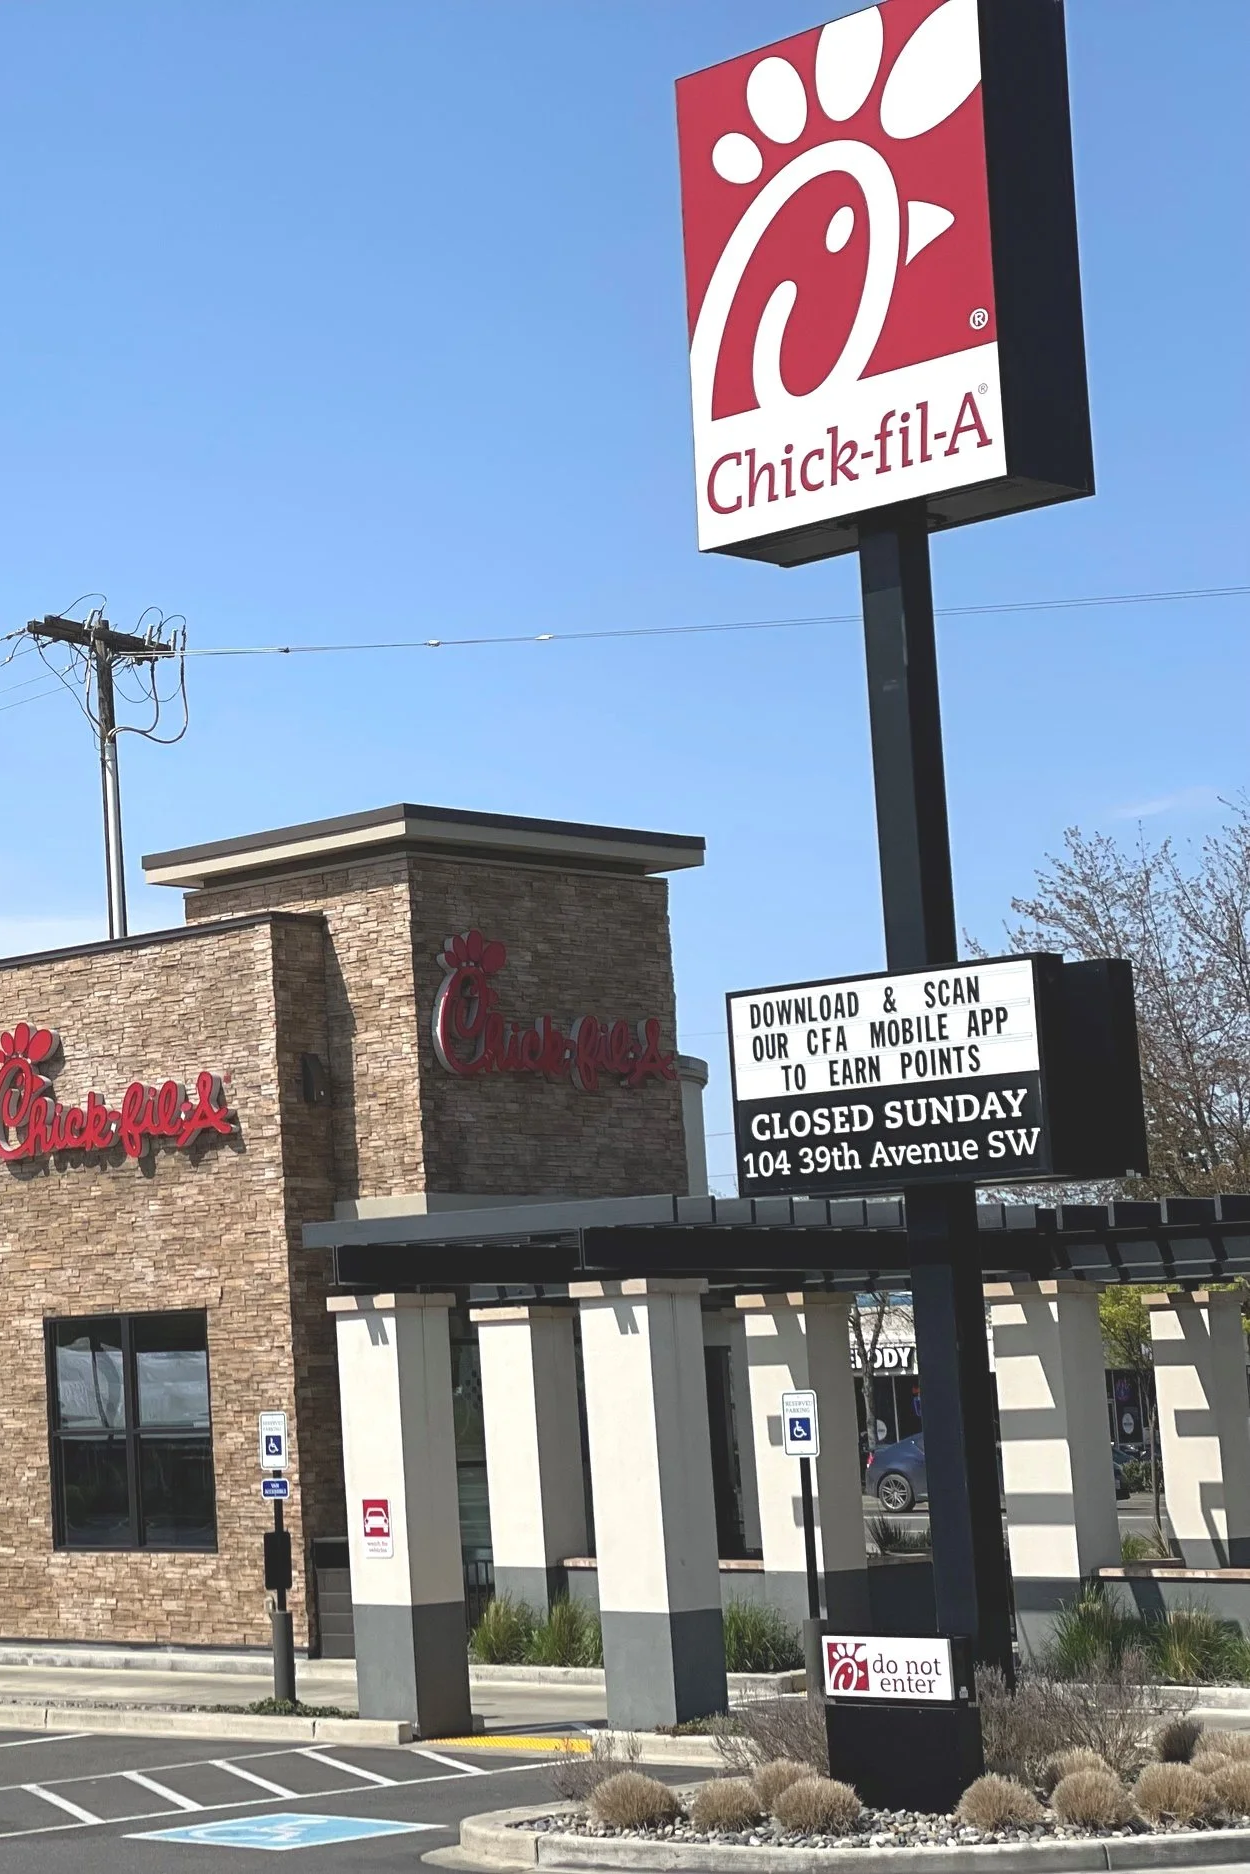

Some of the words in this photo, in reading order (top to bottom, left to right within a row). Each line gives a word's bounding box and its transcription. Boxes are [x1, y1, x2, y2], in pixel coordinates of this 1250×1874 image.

[707, 392, 993, 515] Chick-fil-A
[437, 966, 678, 1092] Chick-fil-A
[749, 991, 860, 1029] DOWNLOAD
[882, 986, 897, 1014] &
[923, 975, 981, 1009] SCAN
[752, 1031, 789, 1062] OUR
[806, 1026, 848, 1056] CFA
[870, 1013, 949, 1048] MOBILE
[967, 1006, 1009, 1038] APP
[781, 1064, 806, 1091] TO
[829, 1055, 881, 1087] EARN
[900, 1044, 981, 1079] POINTS
[751, 1103, 874, 1142] CLOSED
[884, 1088, 1028, 1130] SUNDAY
[743, 1150, 791, 1178] 104
[798, 1142, 860, 1174] 39th
[870, 1138, 978, 1169] Avenue
[988, 1127, 1041, 1158] SW
[872, 1653, 898, 1675] do
[905, 1658, 942, 1676] not
[880, 1675, 936, 1694] enter
